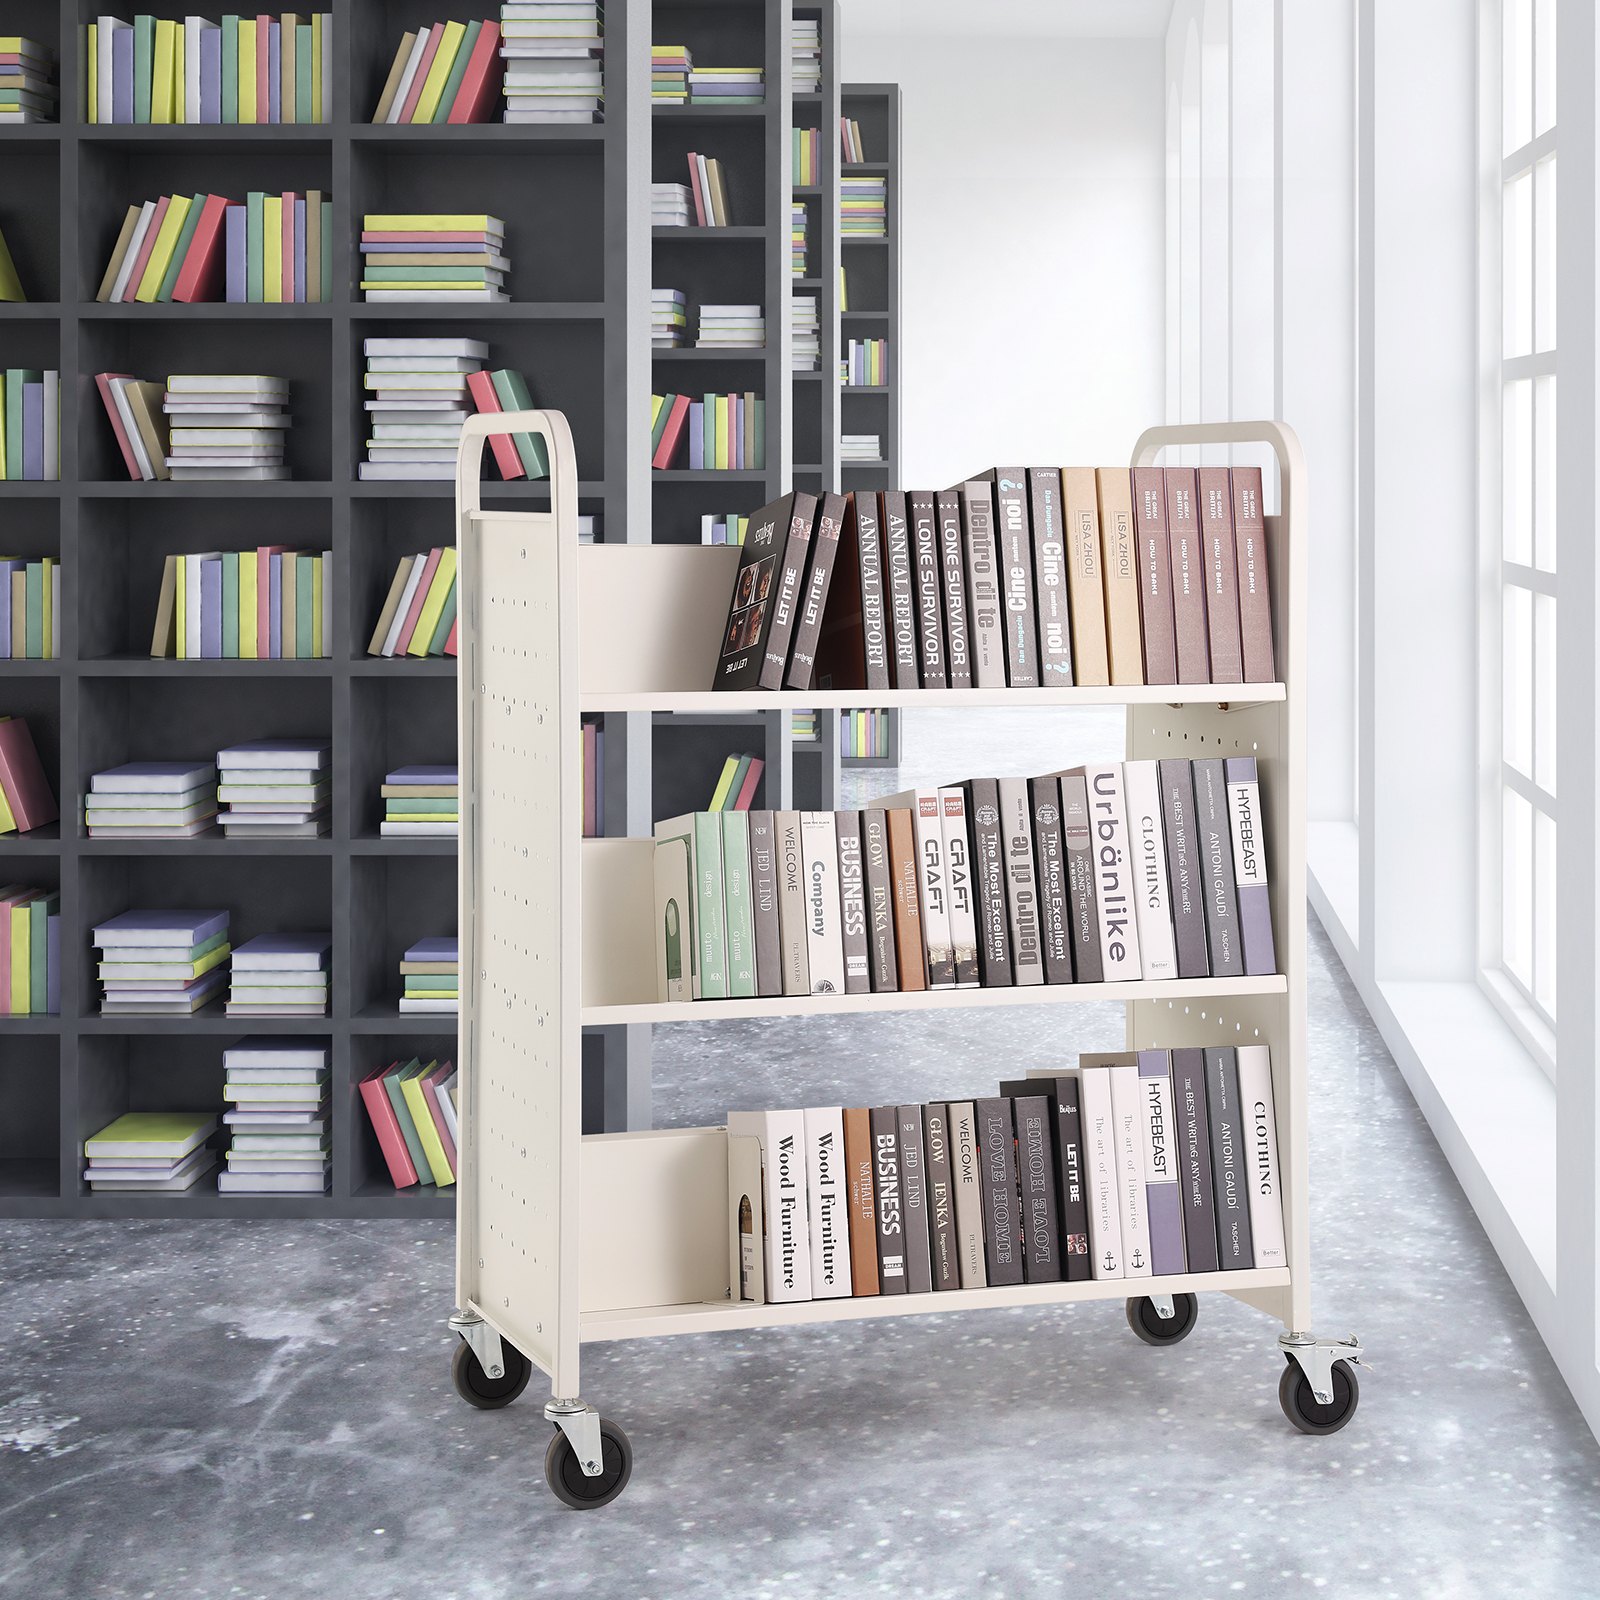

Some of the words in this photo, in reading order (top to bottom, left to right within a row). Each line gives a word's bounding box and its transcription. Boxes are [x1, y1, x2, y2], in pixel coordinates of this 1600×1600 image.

[1002, 498, 1022, 530] noi
[1082, 513, 1090, 542] LISA
[1118, 514, 1127, 542] LISA
[860, 514, 878, 589] ANNUAL
[890, 514, 908, 589] ANNUAL
[918, 519, 934, 565] LONE
[944, 519, 960, 565] LONE
[970, 500, 991, 574] Dentro
[786, 568, 797, 585] BE
[815, 567, 826, 585] BE
[1042, 541, 1062, 586] Cine
[1083, 544, 1094, 576] ZHOU
[1120, 544, 1130, 576] ZHOU
[1150, 560, 1156, 572] TO
[1182, 560, 1187, 572] TO
[1215, 560, 1221, 571] TO
[1248, 560, 1254, 571] TO
[782, 586, 793, 603] IT
[810, 586, 822, 603] IT
[974, 579, 996, 600] di
[1008, 566, 1027, 612] Cine
[777, 602, 792, 626] LET
[805, 602, 820, 626] LET
[865, 594, 884, 668] REPORT
[895, 594, 914, 666] REPORT
[921, 570, 940, 666] SURVIVOR
[948, 570, 966, 666] SURVIVOR
[978, 607, 995, 628] te
[1046, 622, 1068, 654] noi
[726, 664, 734, 674] BE
[734, 660, 740, 670] IT
[739, 657, 748, 669] LET
[1174, 802, 1184, 827] BEST
[987, 832, 997, 858] The
[1011, 836, 1028, 858] te
[1048, 832, 1058, 857] The
[1236, 788, 1258, 879] HYPEBEAST
[755, 848, 770, 872] JED
[785, 827, 798, 892] WELCOME
[1093, 773, 1128, 962] Urbänlike
[1141, 816, 1160, 909] CLOTHING
[1210, 832, 1222, 877] ANTONI
[704, 870, 714, 898] design
[732, 870, 741, 897] design
[840, 836, 864, 936] BUSINESS
[904, 860, 918, 917] NATHALIE
[924, 838, 944, 914] CRAFT
[950, 838, 969, 914] CRAFT
[989, 862, 1000, 895] Most
[1011, 864, 1032, 884] di
[1050, 860, 1060, 894] Most
[760, 880, 772, 912] LIND
[811, 860, 825, 937] Company
[1076, 855, 1086, 891] AROUND
[1081, 911, 1090, 942] WORLD
[1214, 879, 1229, 917] GAUDÍ
[733, 930, 741, 961] muuto
[991, 898, 1005, 962] Excellent
[1016, 890, 1038, 966] Dentro
[1052, 898, 1066, 960] Excellent
[1222, 928, 1230, 963] TASCHEN
[704, 932, 712, 962] muuto
[1186, 1092, 1196, 1118] BEST
[1096, 1116, 1104, 1134] The
[1124, 1114, 1133, 1132] The
[1148, 1082, 1167, 1176] HYPEBEAST
[778, 1134, 796, 1189] Wood
[818, 1131, 835, 1186] Wood
[904, 1144, 917, 1168] JED
[959, 1118, 973, 1184] WELCOME
[988, 1118, 1006, 1182] LOVE
[1026, 1118, 1045, 1192] HOME
[1066, 1144, 1077, 1168] LET
[1221, 1122, 1234, 1168] ANTONI
[1254, 1101, 1272, 1196] CLOTHING
[1068, 1168, 1078, 1184] IT
[1099, 1162, 1106, 1176] of
[1128, 1160, 1134, 1173] of
[859, 1162, 872, 1220] NATHALIE
[876, 1134, 900, 1236] BUSINESS
[906, 1176, 920, 1208] LIND
[1070, 1184, 1080, 1202] BE
[1225, 1170, 1239, 1210] GAUDÍ
[1100, 1180, 1110, 1232] libraries
[1128, 1178, 1138, 1230] libraries
[781, 1196, 797, 1289] Furniture
[821, 1193, 837, 1285] Furniture
[994, 1188, 1012, 1264] HOME
[1032, 1198, 1050, 1264] LOVE
[1231, 1221, 1240, 1256] TASCHEN
